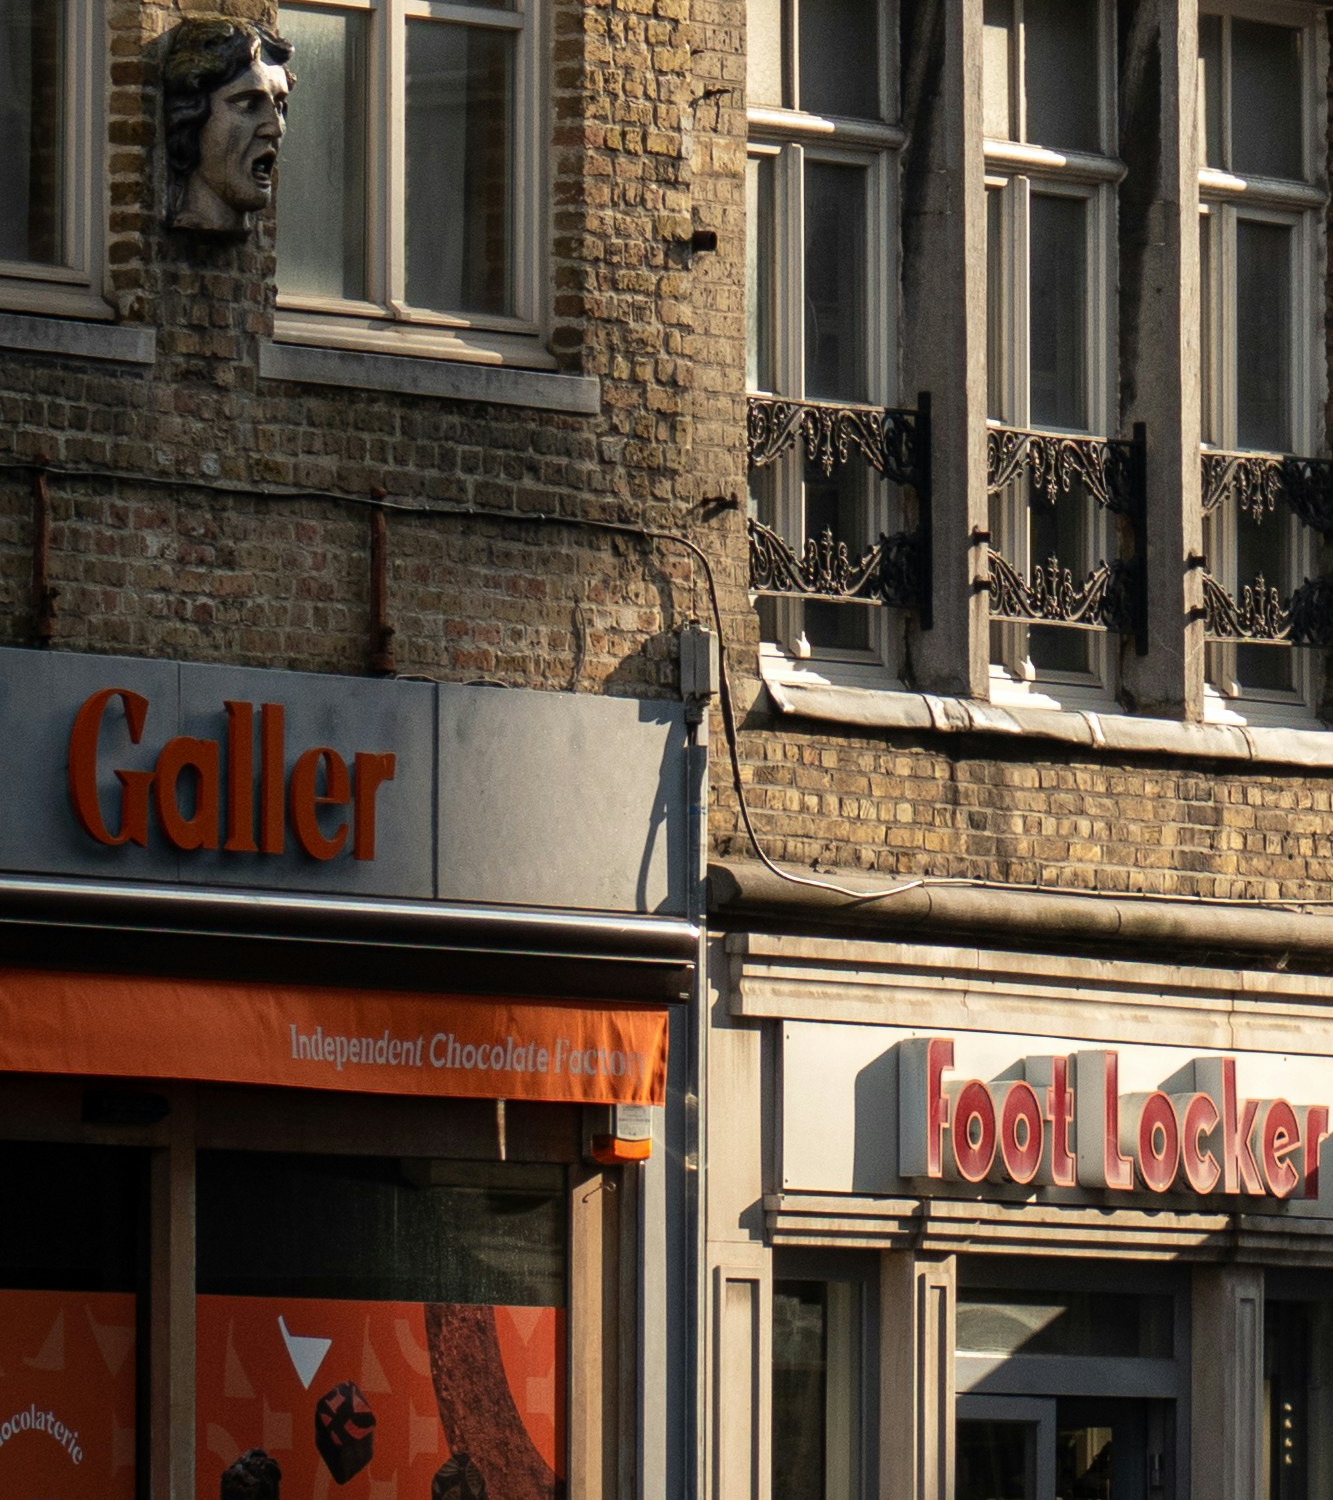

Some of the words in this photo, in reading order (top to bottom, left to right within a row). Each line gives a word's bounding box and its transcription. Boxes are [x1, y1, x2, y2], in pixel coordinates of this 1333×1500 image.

[68, 687, 397, 862] Galler
[289, 1023, 423, 1072] Independent
[428, 1032, 547, 1074] Chocolate
[1088, 1049, 1330, 1200] Locker
